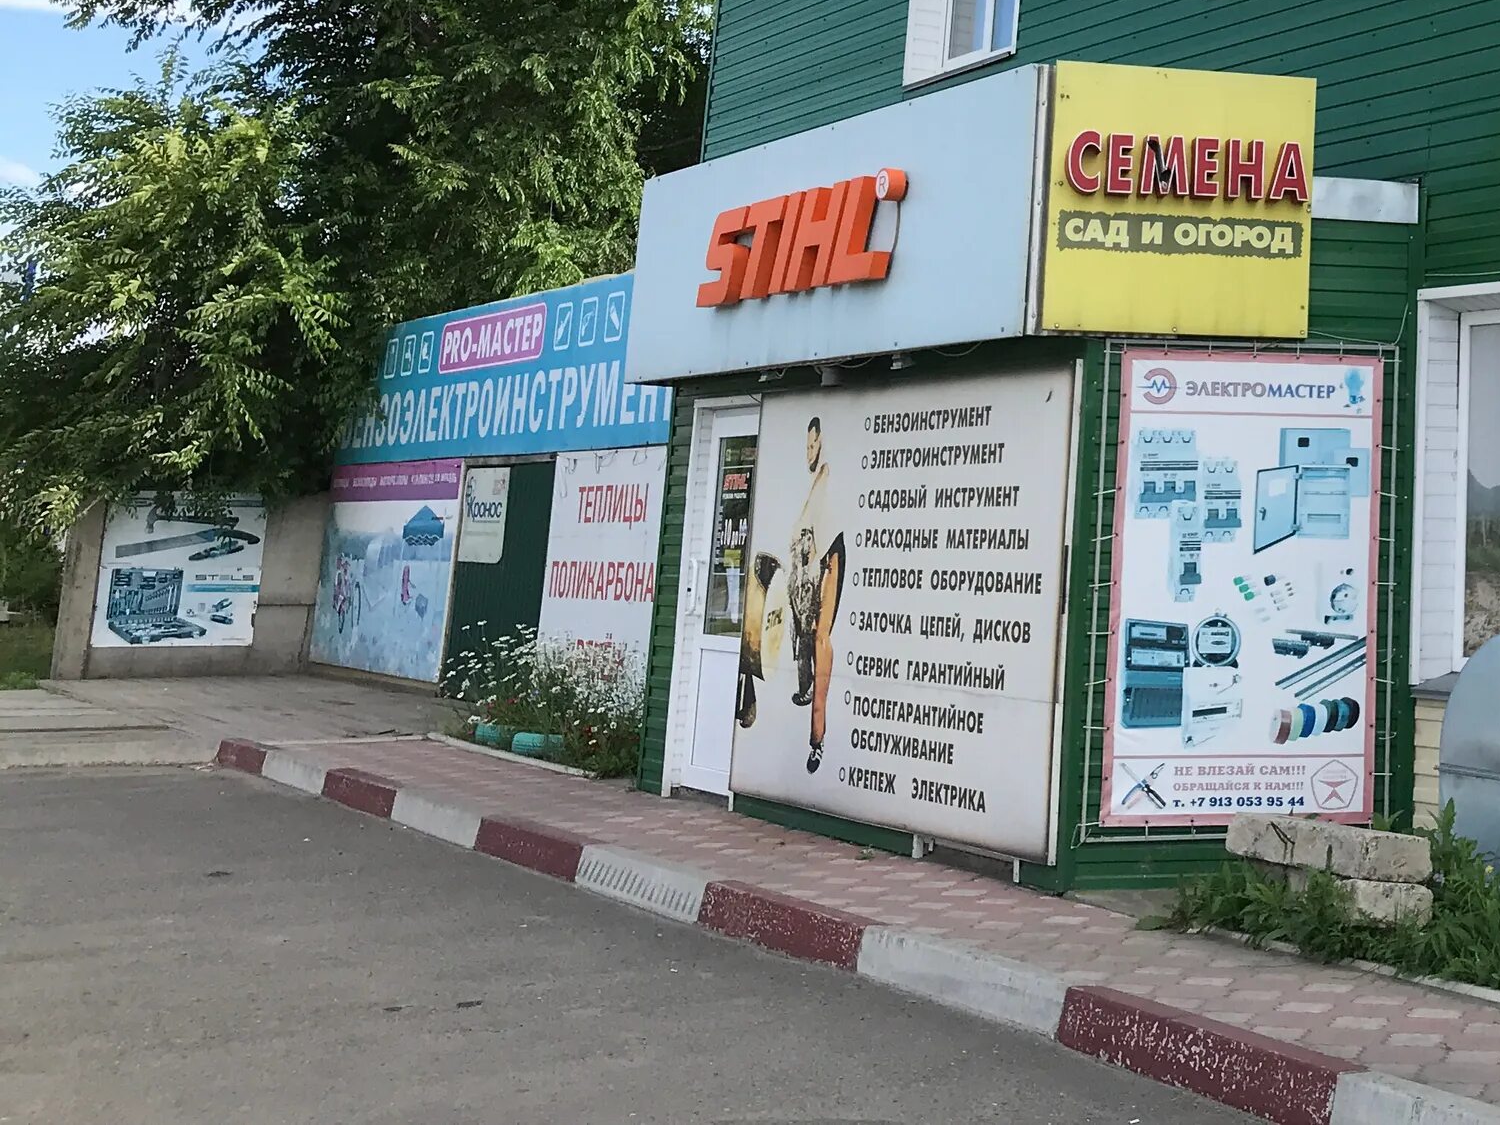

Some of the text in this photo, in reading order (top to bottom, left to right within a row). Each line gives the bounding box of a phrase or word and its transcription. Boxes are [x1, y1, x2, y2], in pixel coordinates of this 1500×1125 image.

[1065, 128, 1310, 204] СЕМЕНА
[696, 175, 892, 308] STIHL
[1064, 217, 1295, 255] САД И ОГОРОД
[442, 311, 544, 365] PRO-МАСТЕР
[1185, 381, 1336, 400] ЭЛЕКТРОМАСТЕР
[873, 405, 992, 434] БЕНЗОИНСТРУМЕНТ
[870, 442, 1005, 469] ЭЛЕКТРОИНСТРУМЕНТ
[578, 483, 650, 530] ТЕПЛИЦЫ
[867, 484, 1020, 512] САДОВЫЙ ИНСТРУМЕНТ
[864, 528, 1029, 552] РАСХОДНЫЕ МАТЕРИАЛЫ
[862, 567, 1042, 596] ТЕПЛОВОЕ ОБОРУДОВАНИЕ
[858, 611, 1031, 644] ЗАТОЧКА ЦЕПЕЙ, ДИСКОВ
[855, 655, 1006, 691] СЕРВИС ГАРАНТИЙНЫЙ
[853, 695, 984, 734] ПОСЛЕГАРАНТИЙНОЕ
[851, 727, 954, 765] ОБСЛУЖИВАНИЕ
[1174, 766, 1193, 776] НЕ
[1197, 763, 1255, 776] ВЛЕЗАЙ
[1259, 765, 1307, 776] САМ!!!
[848, 766, 986, 813] КРЕПЕЖ ЭЛЕКТРИКА
[1173, 781, 1304, 792] ОБРАЩАЙСЯ К НАМ!!!
[1190, 797, 1205, 807] +7
[1208, 797, 1233, 807] 913
[1236, 797, 1263, 807] 053
[1267, 797, 1284, 807] 95
[1287, 796, 1305, 807] 44
